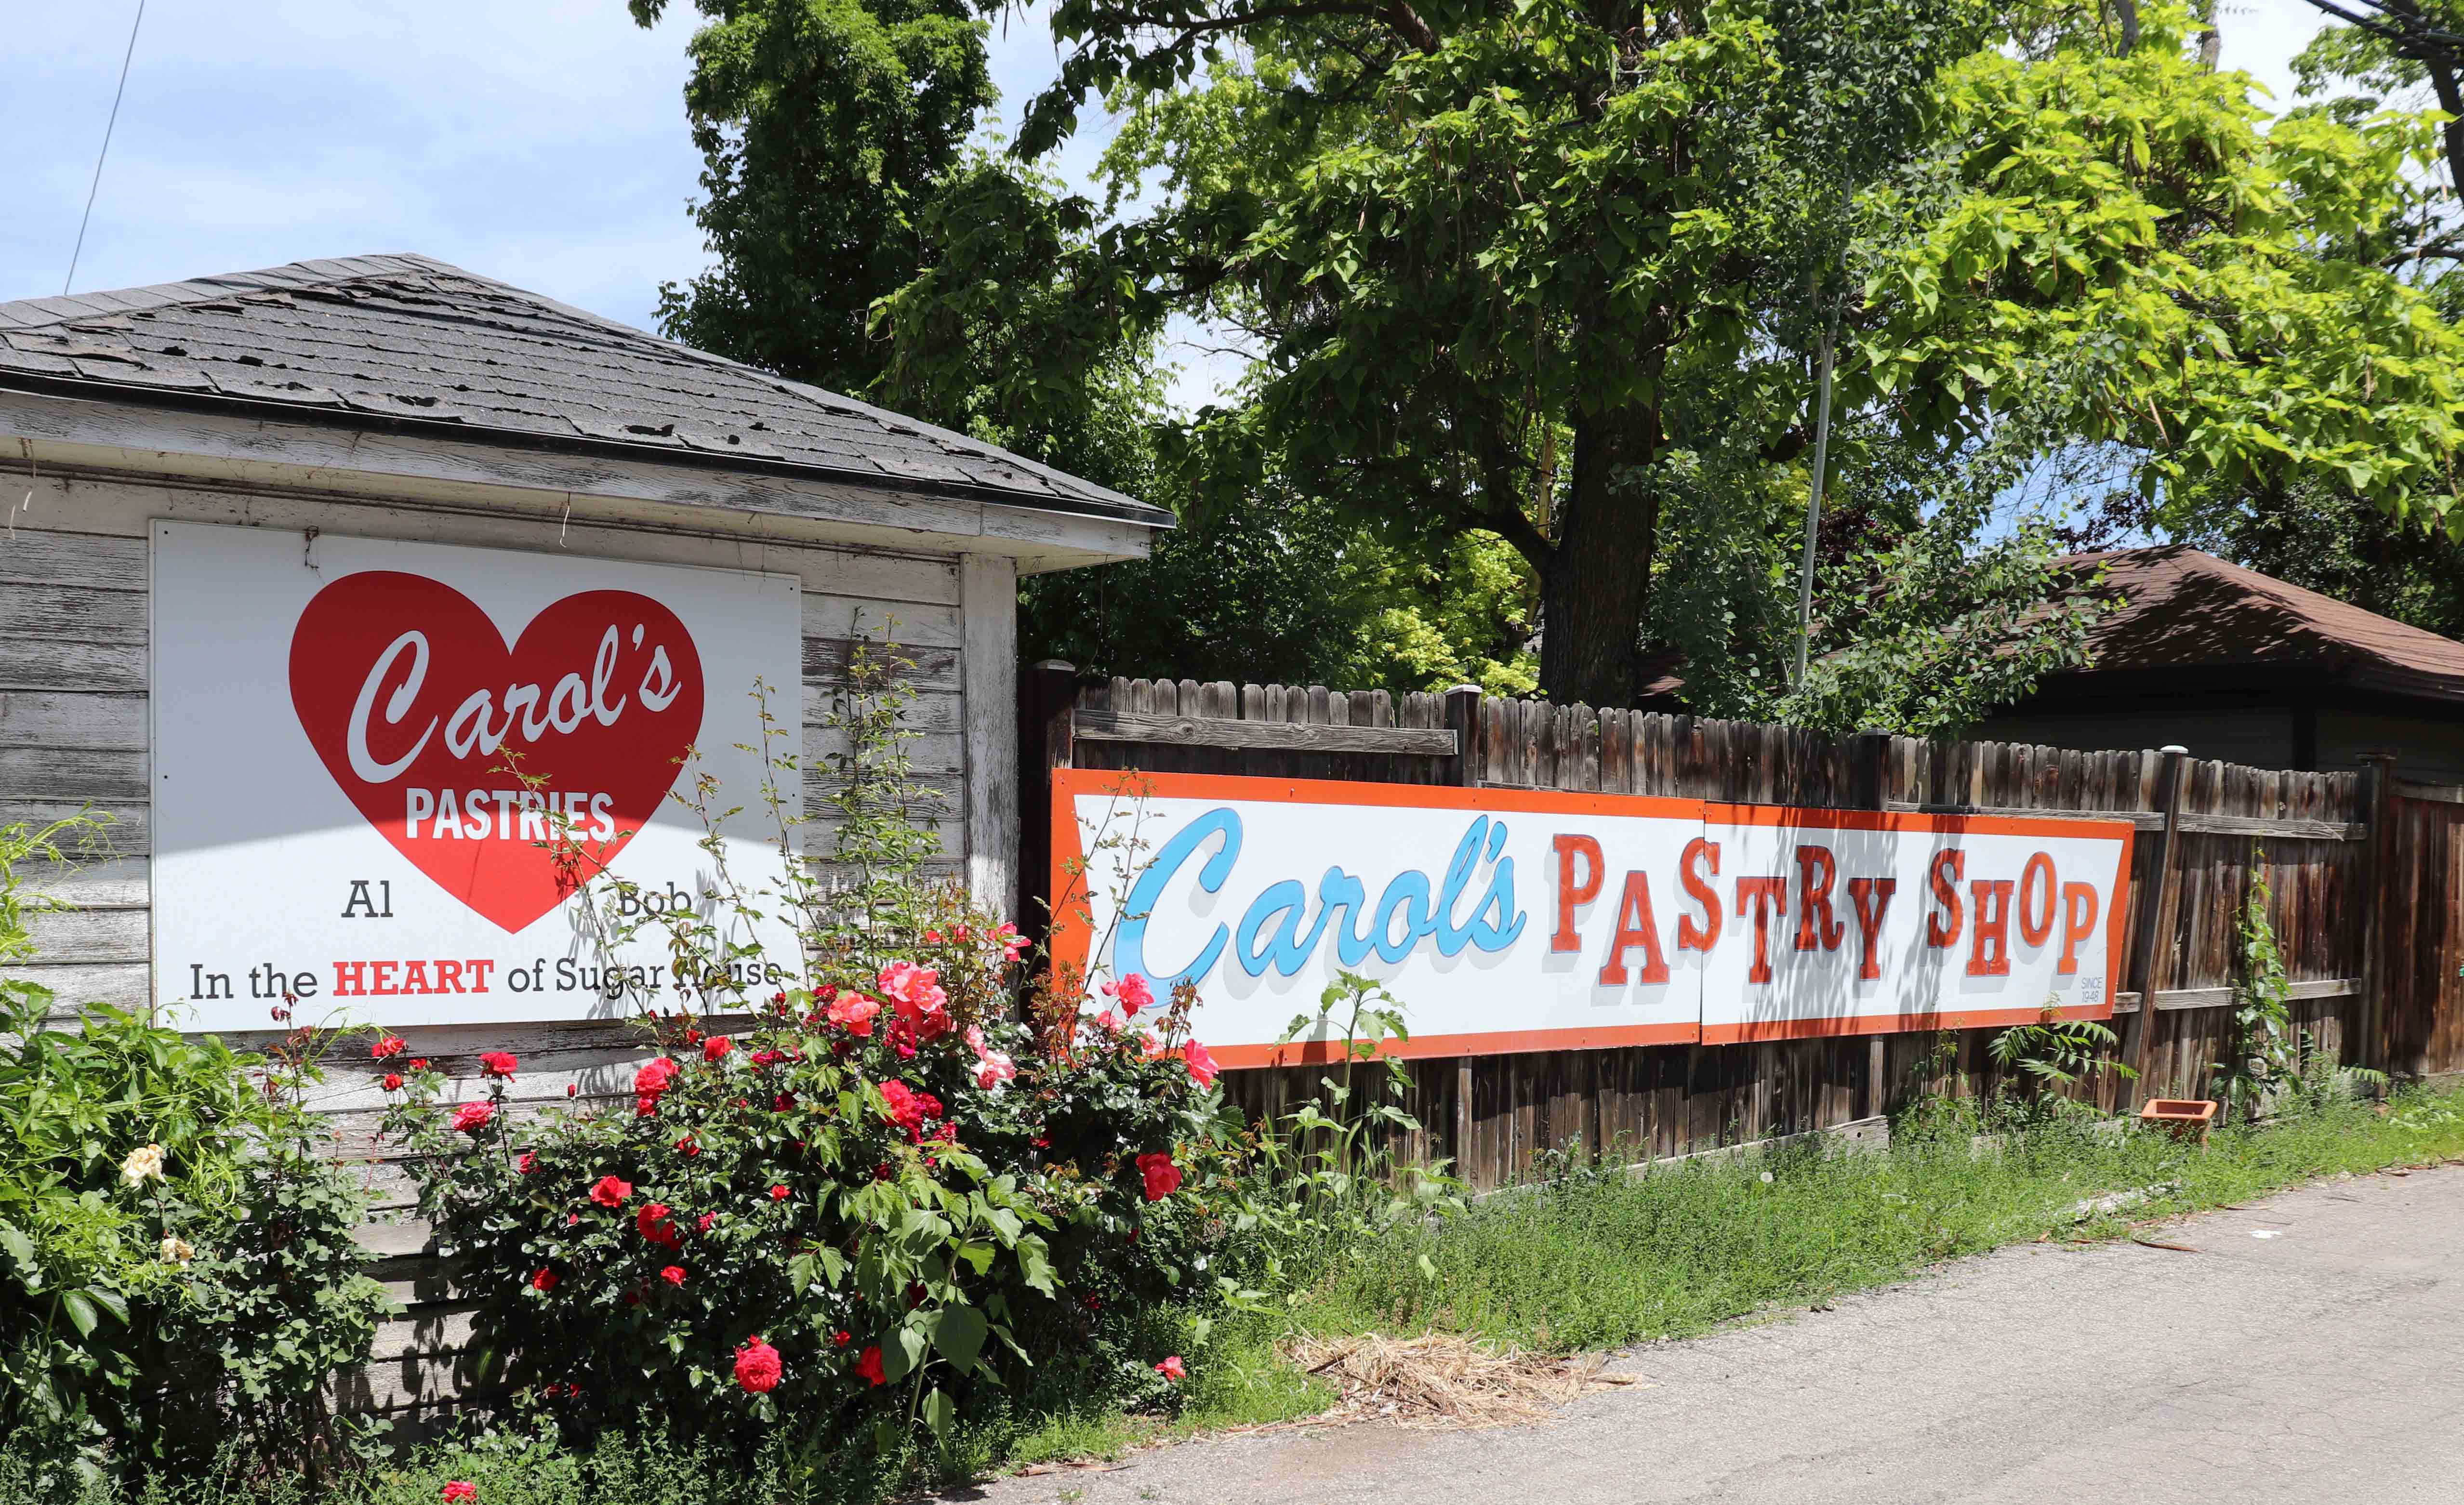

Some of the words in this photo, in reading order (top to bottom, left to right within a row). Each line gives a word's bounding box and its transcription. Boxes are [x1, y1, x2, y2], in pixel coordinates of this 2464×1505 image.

[346, 623, 682, 784] Carol's
[405, 788, 616, 841] PASTRIES
[341, 880, 394, 918] Al
[618, 881, 692, 916] Bob
[1113, 807, 1527, 1008] Carol's
[1550, 832, 1897, 987] PASTRY
[1927, 847, 2100, 977] SHOP
[190, 964, 234, 1000] In
[248, 963, 318, 998] the
[332, 959, 494, 996] HEART
[508, 958, 546, 992] of
[556, 957, 665, 1000] Sugar
[2081, 977, 2103, 989] SINCE
[2081, 990, 2099, 1003] 1948
